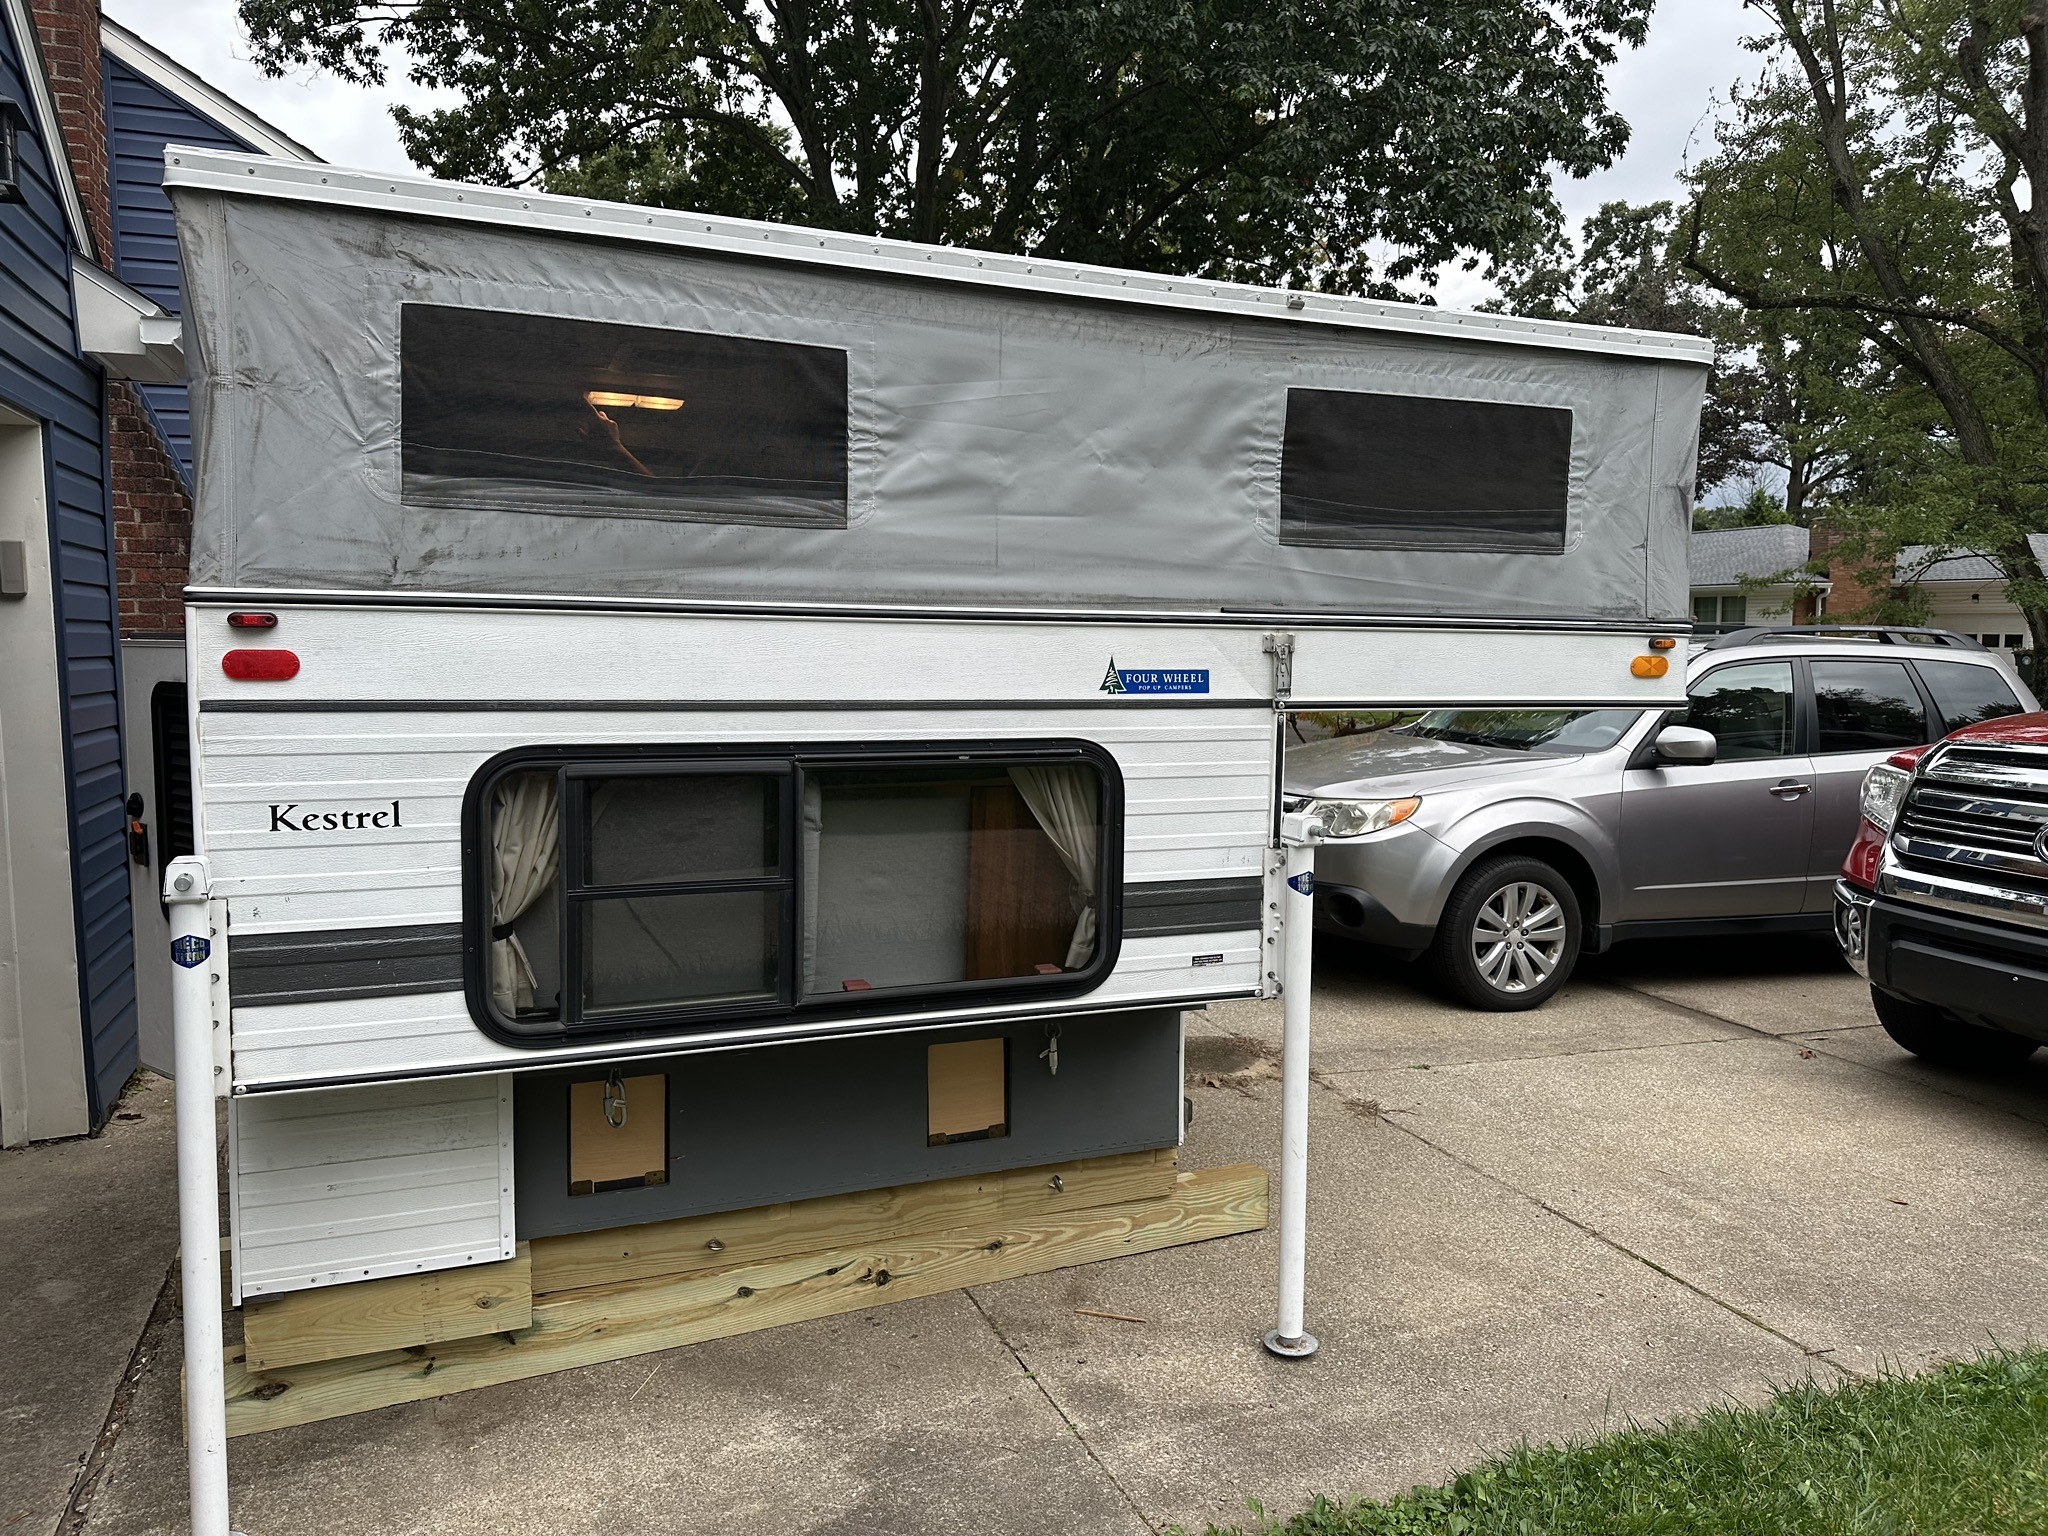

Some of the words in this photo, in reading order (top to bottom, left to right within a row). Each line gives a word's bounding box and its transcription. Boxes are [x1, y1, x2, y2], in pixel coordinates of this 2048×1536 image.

[1125, 673, 1158, 683] FOUR
[1163, 673, 1204, 683] WHEEL
[268, 800, 402, 831] Kestrel
